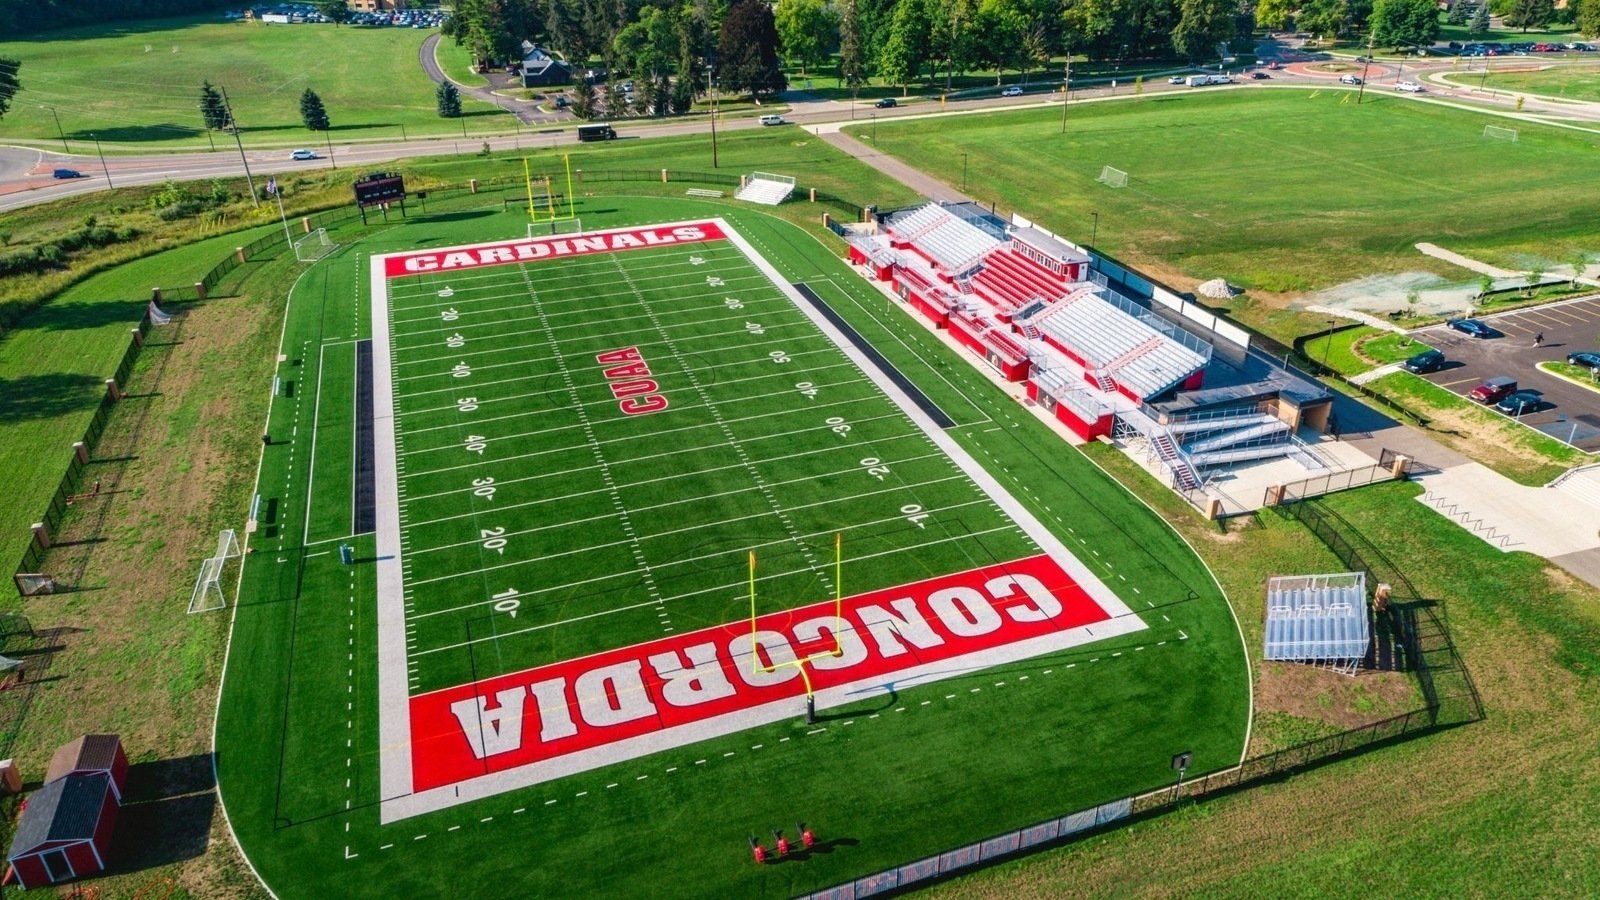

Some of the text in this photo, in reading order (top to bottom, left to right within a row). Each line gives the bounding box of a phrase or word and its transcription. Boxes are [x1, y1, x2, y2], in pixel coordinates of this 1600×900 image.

[404, 226, 706, 273] CARDINALS
[769, 350, 791, 364] 50
[451, 363, 471, 378] 40
[595, 345, 669, 415] CUAA
[795, 381, 818, 396] 40
[457, 397, 478, 412] 50
[825, 416, 851, 433] 30
[465, 434, 487, 451] 40
[860, 457, 890, 476] 20
[472, 476, 496, 497] 30
[900, 504, 929, 523] 10
[480, 526, 508, 550] 20
[492, 587, 520, 612] 10
[450, 573, 1063, 760] CONCORDIA
